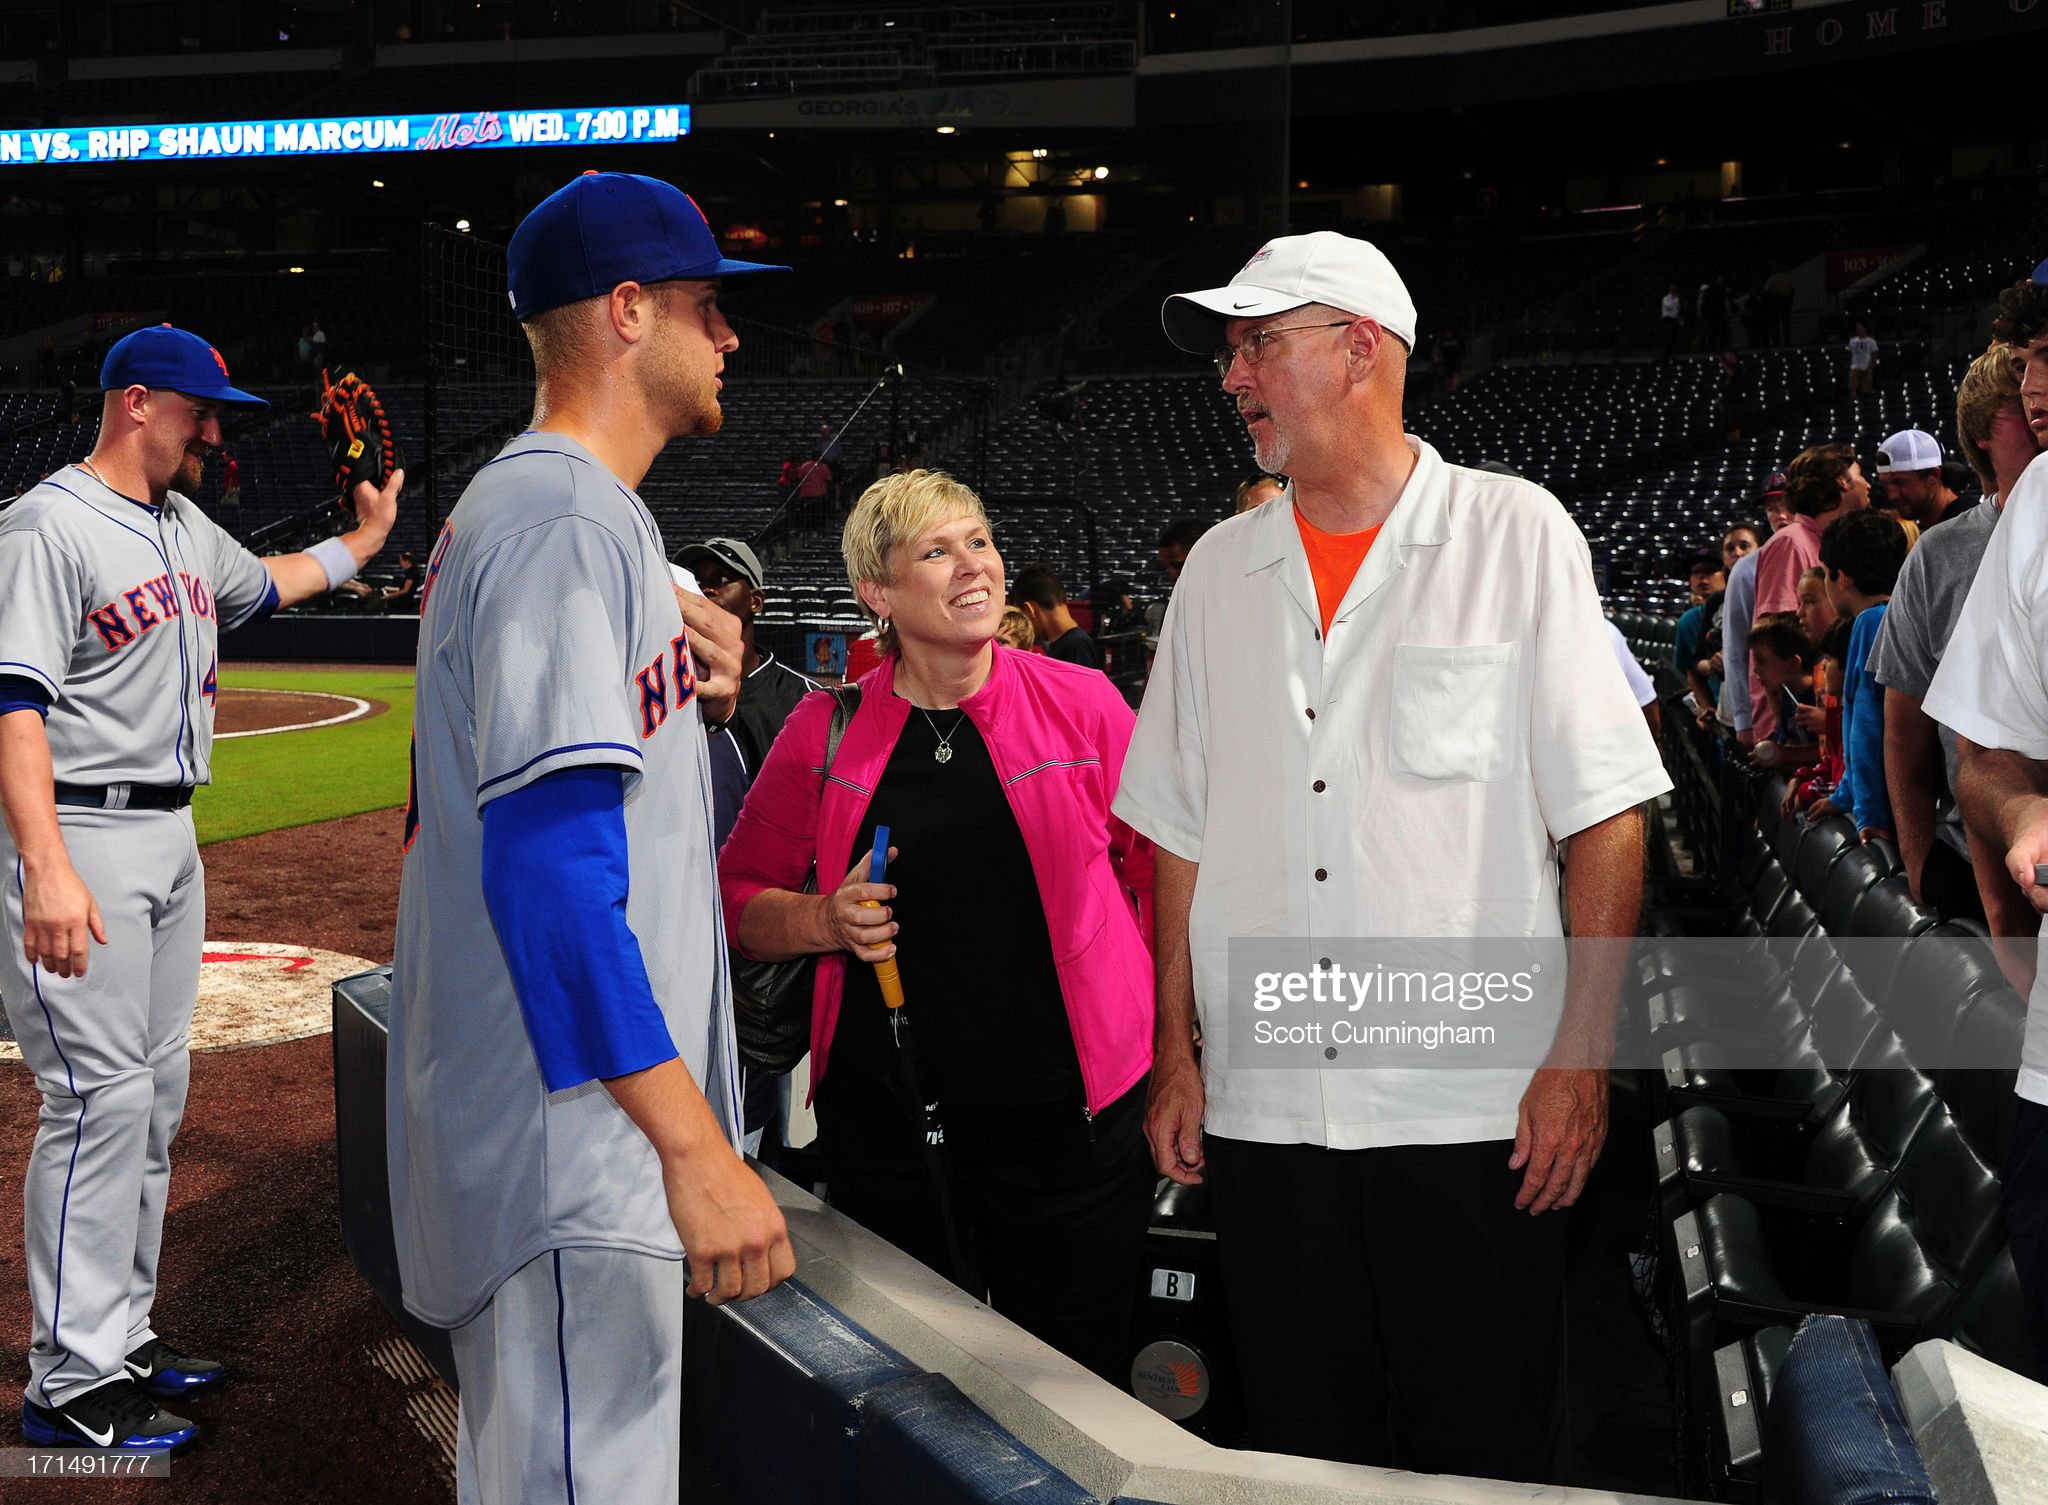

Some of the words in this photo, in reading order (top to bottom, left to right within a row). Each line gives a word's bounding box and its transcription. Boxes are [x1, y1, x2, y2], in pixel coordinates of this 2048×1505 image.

[1764, 0, 1947, 55] HOME
[798, 97, 919, 116] GEORGIA'S
[30, 132, 80, 160] VS.
[88, 129, 150, 159] RHP
[158, 124, 265, 156] SHAUN
[273, 119, 410, 152] MARCUM
[415, 111, 503, 151] Mets
[508, 112, 571, 143] WED.
[575, 110, 628, 140] 7:00
[632, 108, 687, 139] P.M.
[88, 573, 180, 652] NEW
[1166, 1272, 1179, 1297] B
